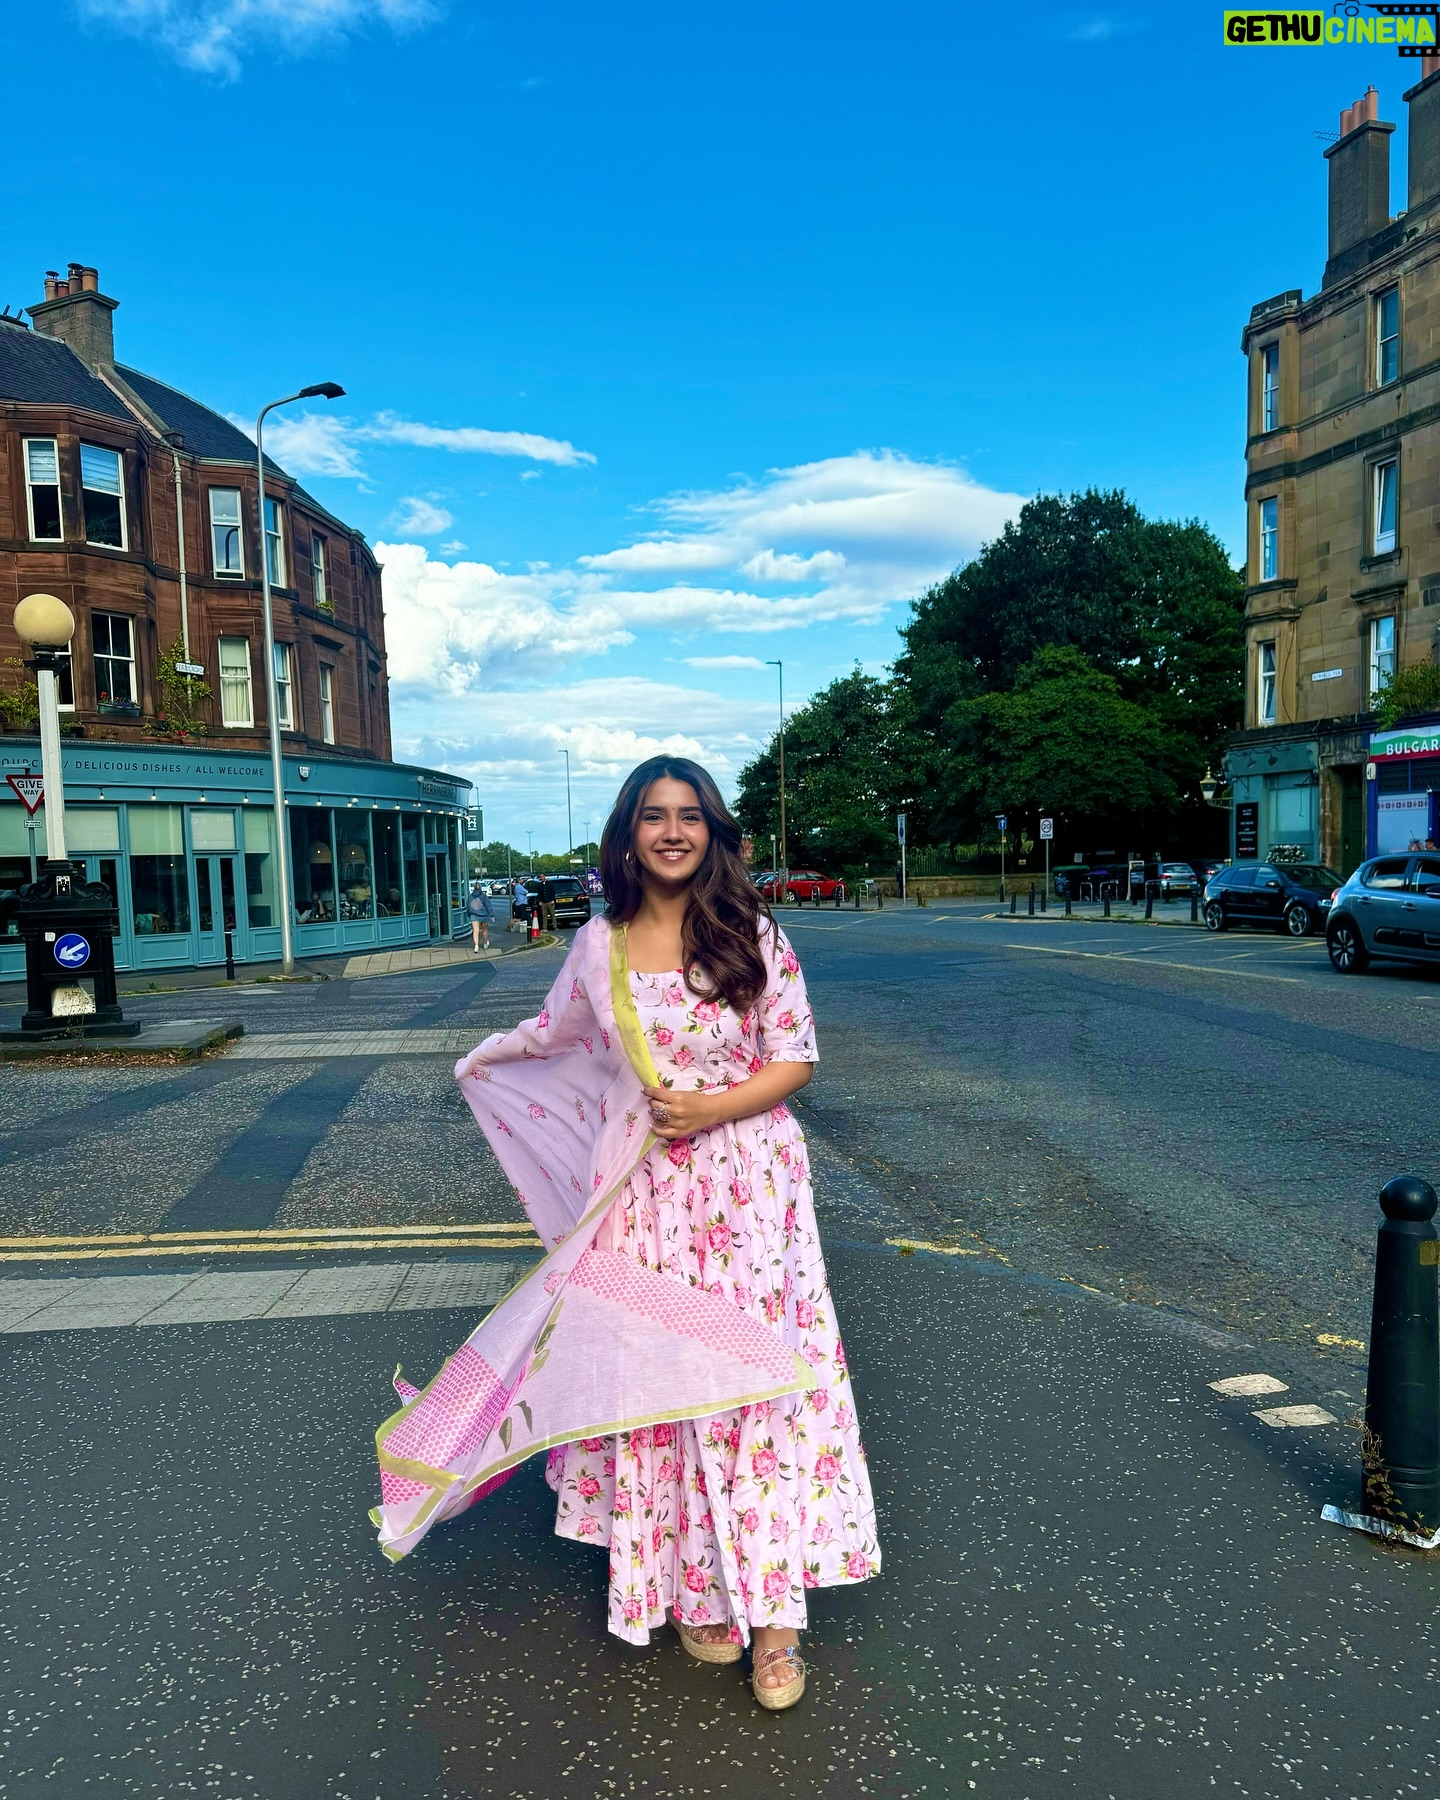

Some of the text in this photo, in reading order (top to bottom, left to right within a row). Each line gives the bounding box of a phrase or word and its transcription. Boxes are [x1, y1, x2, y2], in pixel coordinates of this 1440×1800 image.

[75, 760, 138, 771] DELICIOUS
[142, 763, 181, 773] DISHES
[196, 765, 214, 774] ALL
[218, 767, 265, 776] WELCOME
[16, 780, 43, 789] GIVE
